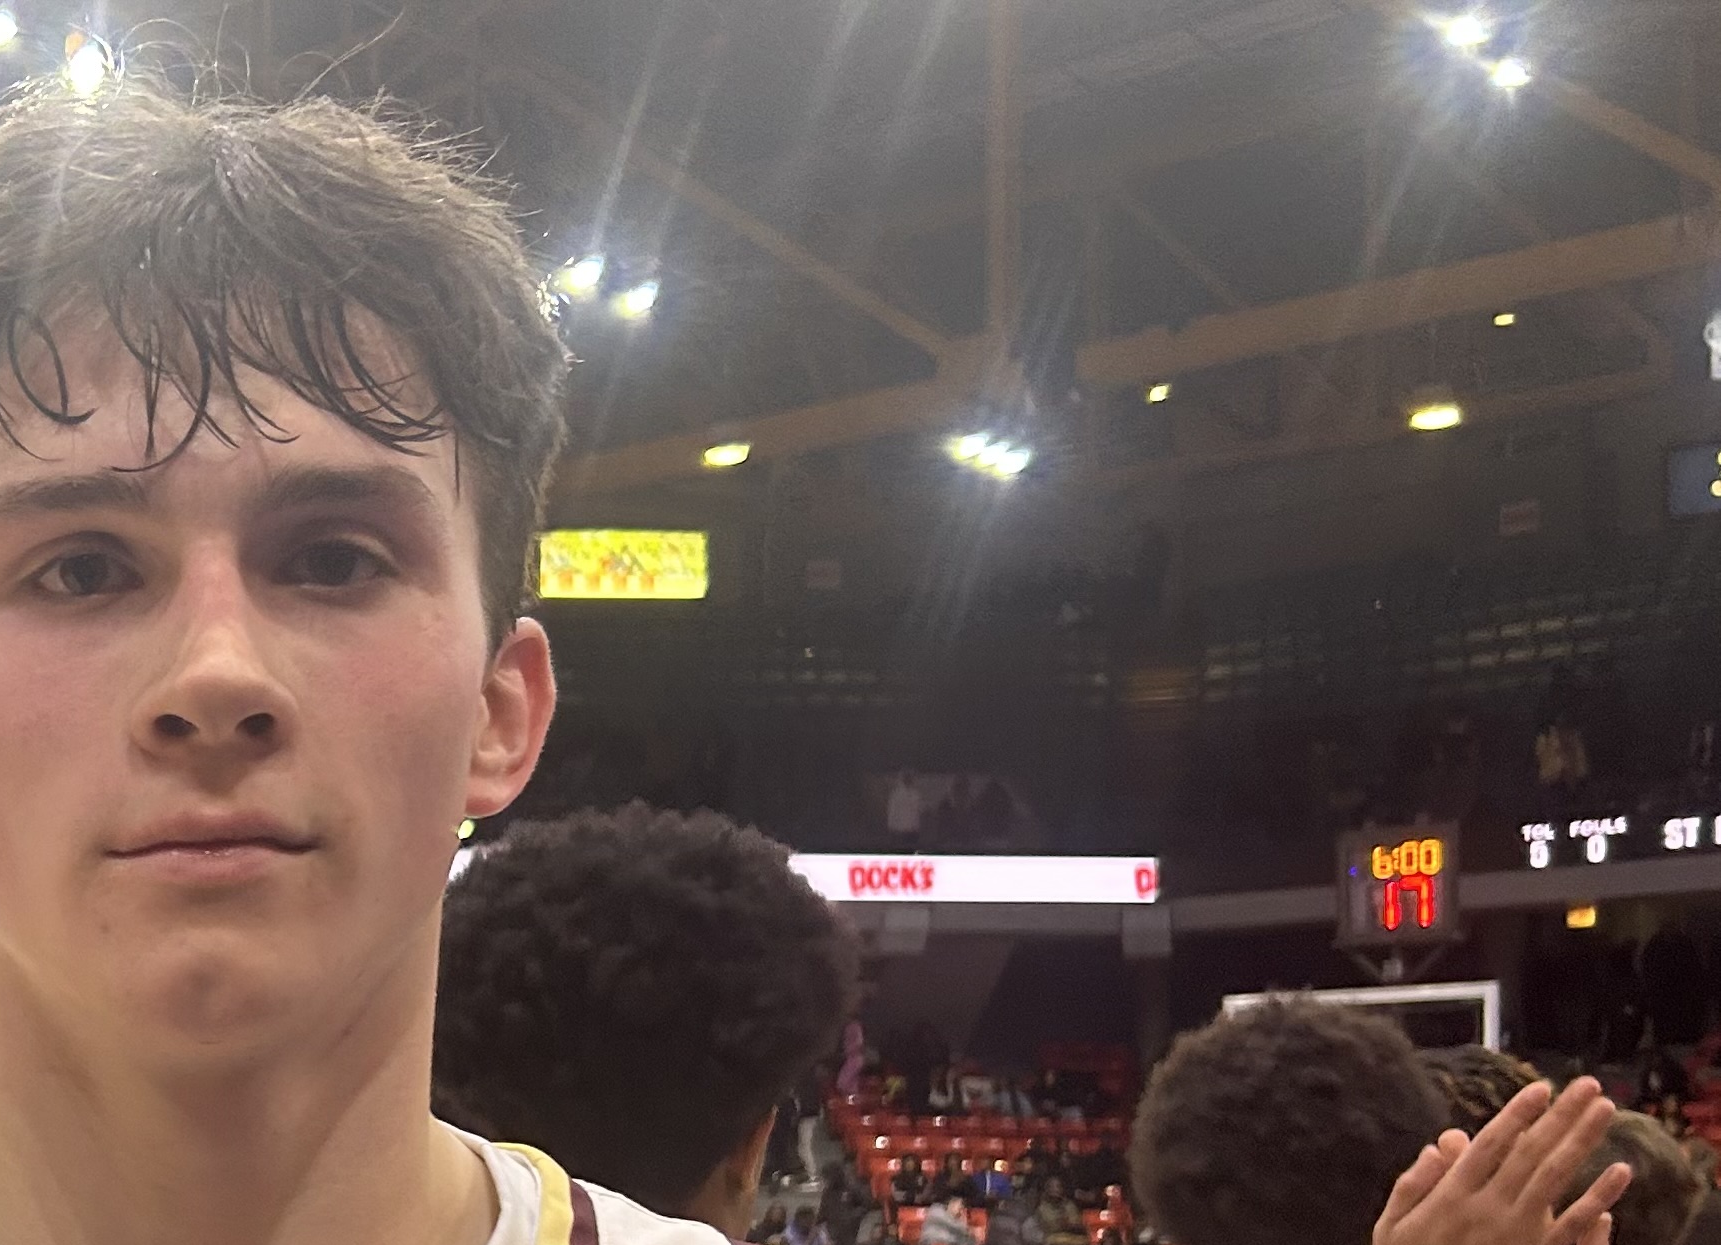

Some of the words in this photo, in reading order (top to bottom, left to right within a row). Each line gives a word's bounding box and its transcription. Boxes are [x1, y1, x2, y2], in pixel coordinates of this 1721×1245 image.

[847, 859, 935, 897] DOCK'S
[1371, 838, 1442, 879] 6:00
[1383, 874, 1434, 930] 17
